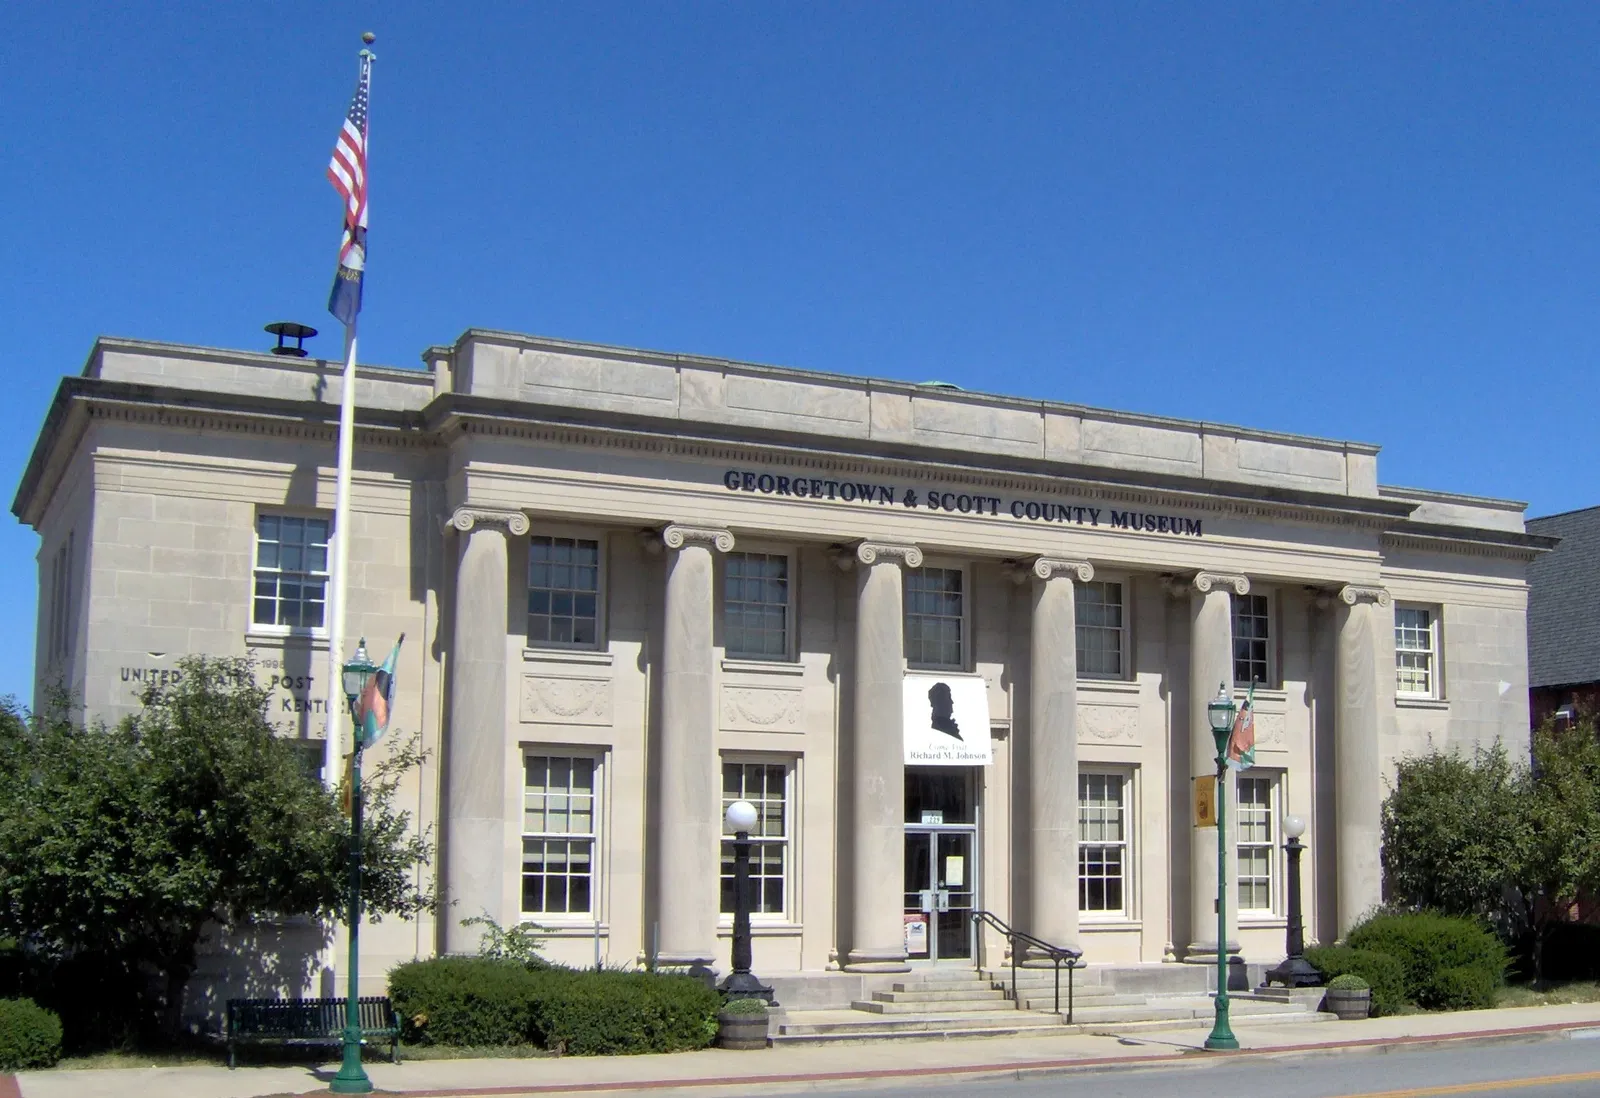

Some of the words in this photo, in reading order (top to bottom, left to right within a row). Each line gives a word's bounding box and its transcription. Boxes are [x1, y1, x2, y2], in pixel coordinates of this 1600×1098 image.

[724, 471, 894, 505] GEORGETOWN
[903, 489, 917, 508] &
[928, 491, 1001, 516] SCOTT
[1011, 501, 1102, 526] COUNTY
[1111, 511, 1203, 537] MUSEUM
[121, 667, 183, 685] UNITED
[271, 674, 314, 691] POST
[910, 752, 941, 760] Richard
[956, 752, 987, 760] Johnson
